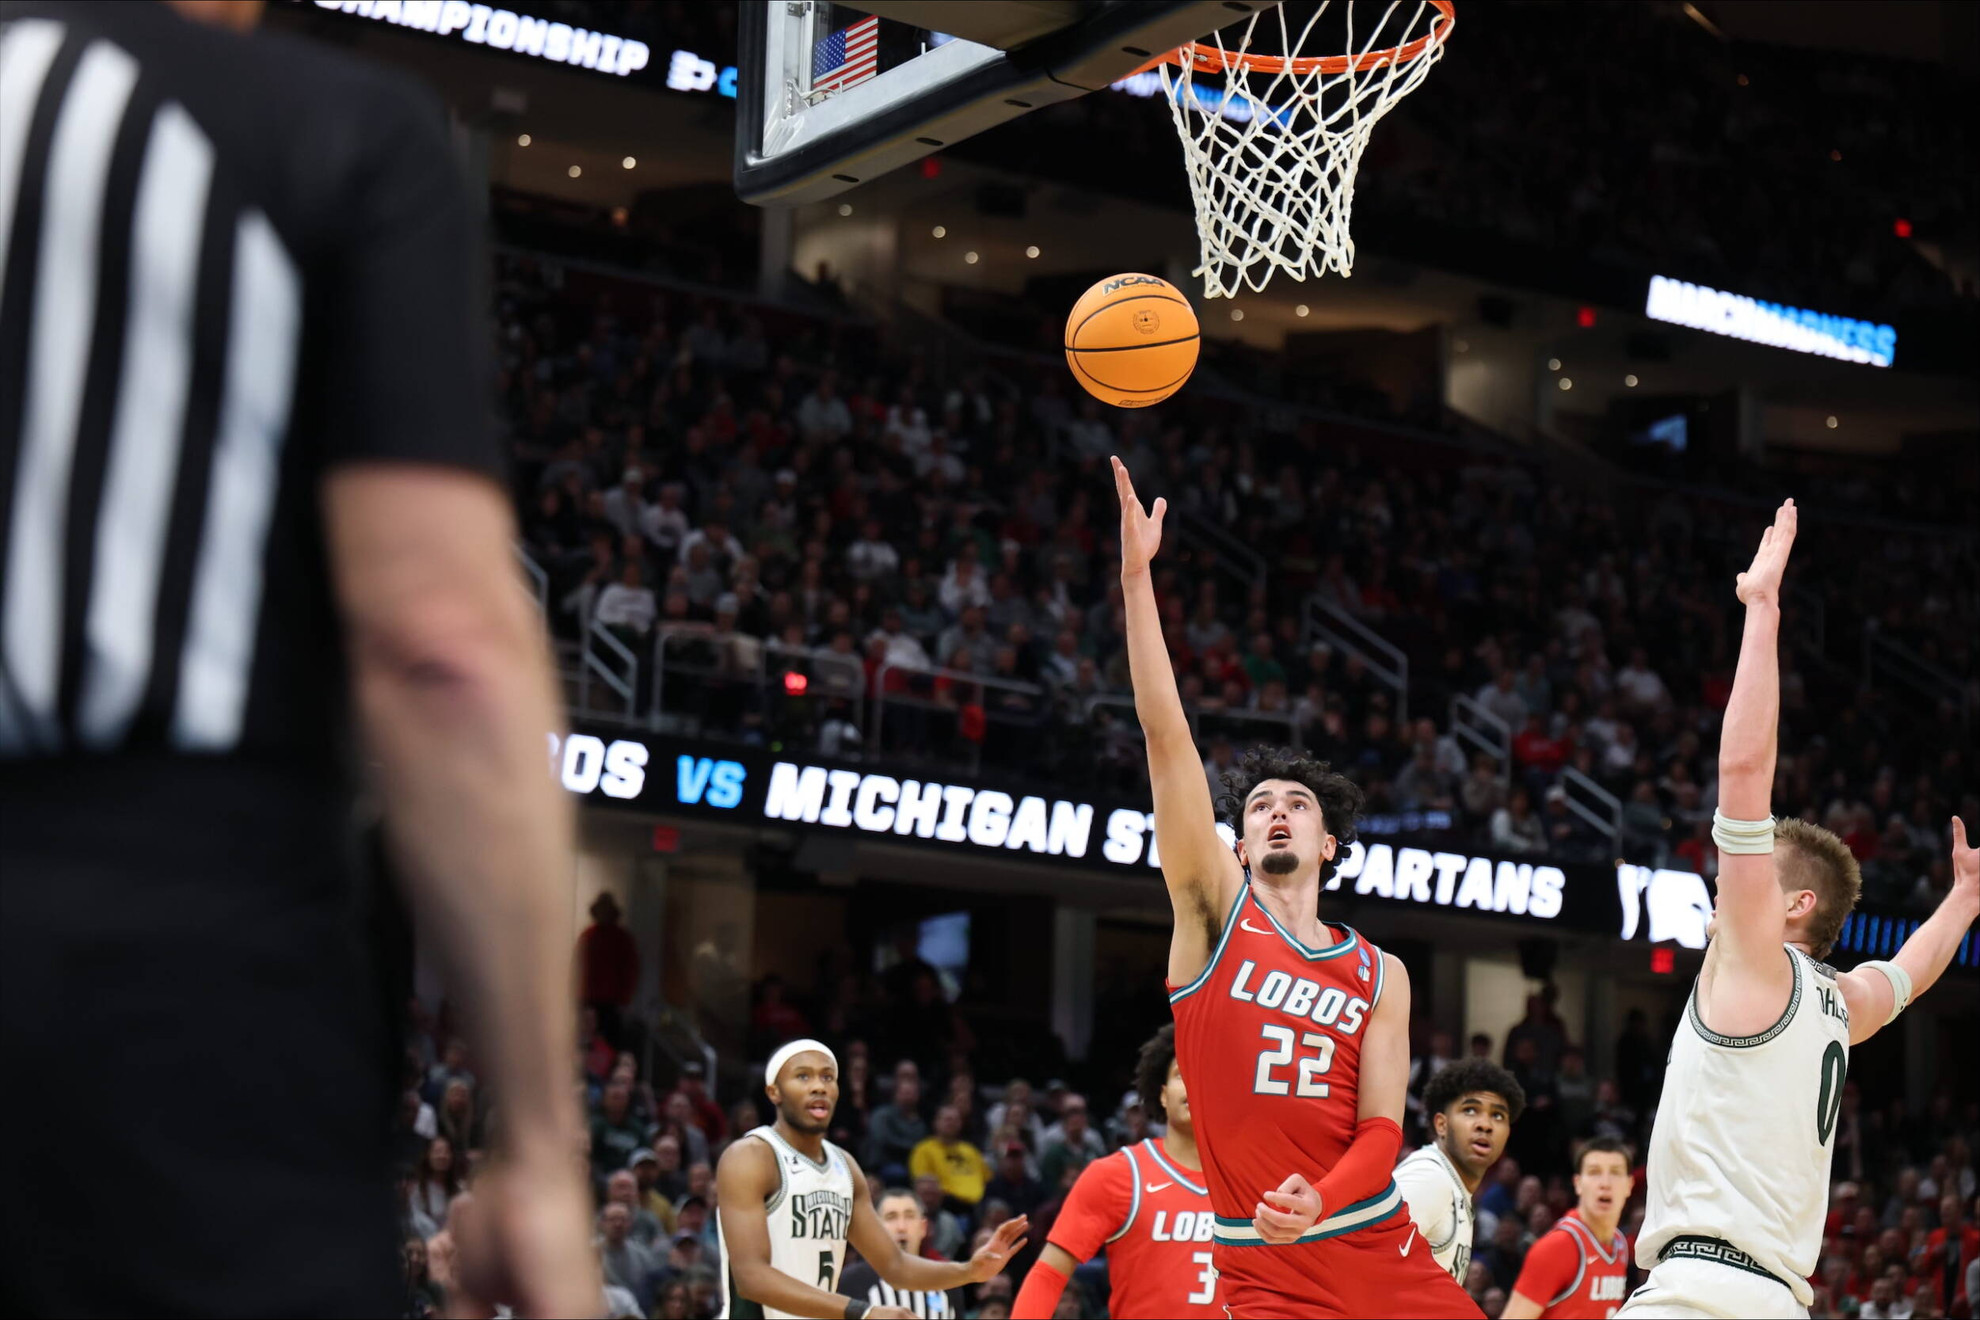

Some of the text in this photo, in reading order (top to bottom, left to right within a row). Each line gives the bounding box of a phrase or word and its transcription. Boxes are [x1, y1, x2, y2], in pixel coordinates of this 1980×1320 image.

[313, 0, 650, 77] AMPIONSHIP
[1103, 276, 1165, 296] NCAA
[547, 732, 649, 799] OS
[677, 754, 747, 809] VS
[764, 761, 1094, 859] MICHIGAN
[1325, 839, 1566, 919] PARTANS
[1230, 960, 1369, 1036] LOBOS
[1253, 1024, 1336, 1099] 22
[1817, 1040, 1847, 1147] 0
[1151, 1210, 1215, 1242] LOB
[1187, 1251, 1217, 1305] 3
